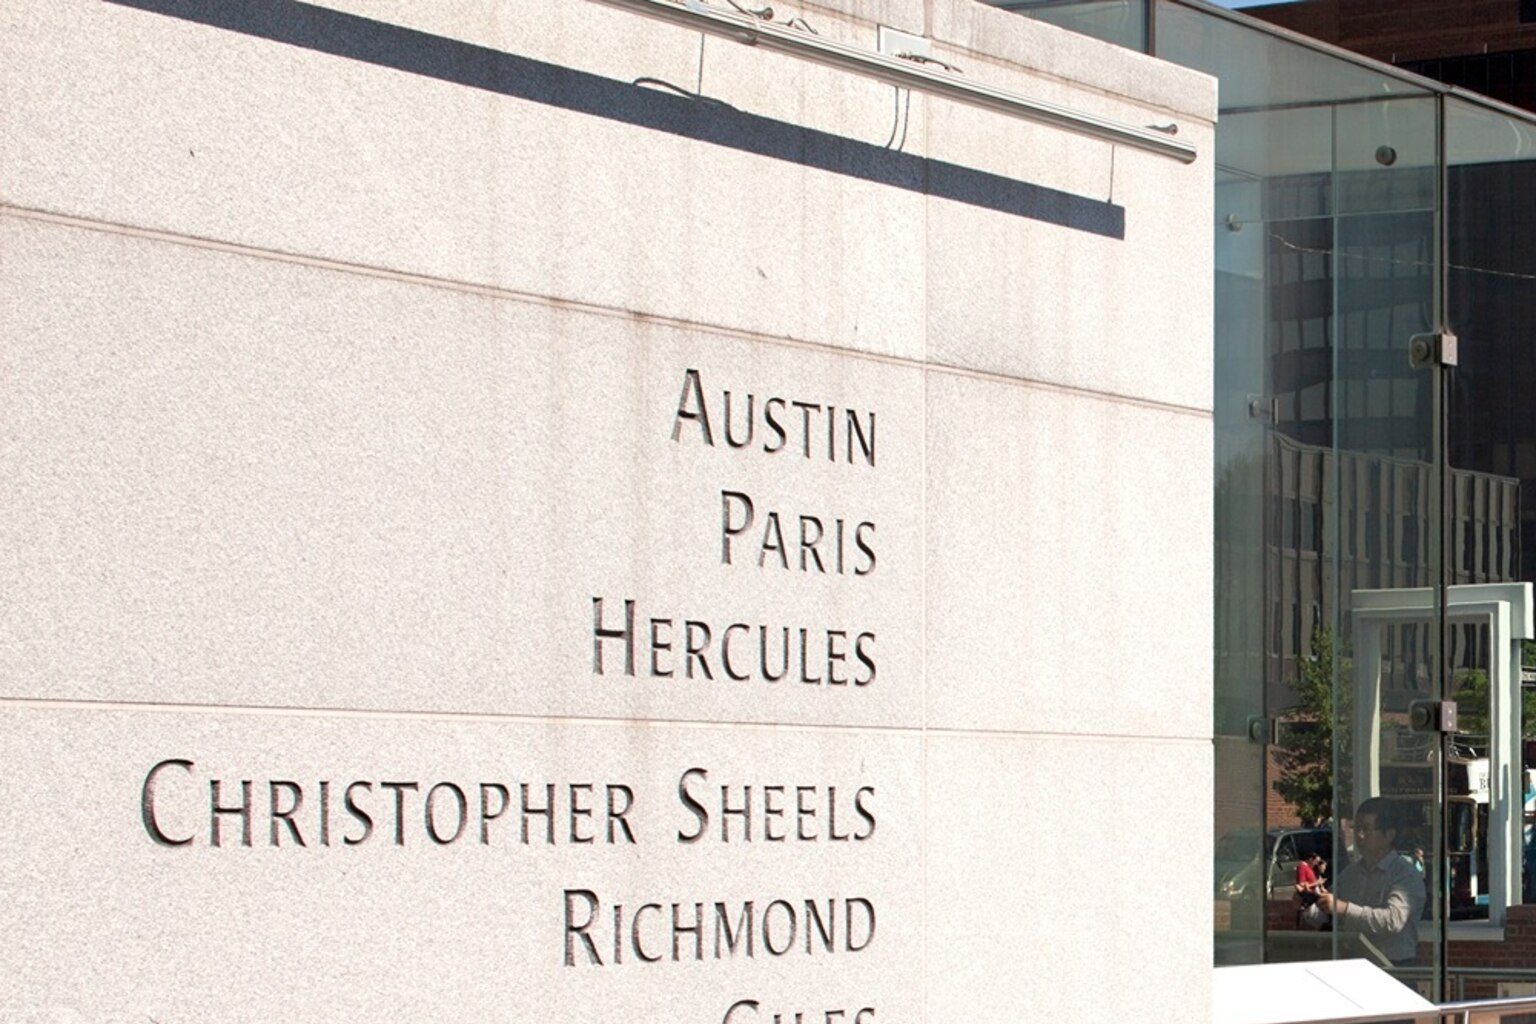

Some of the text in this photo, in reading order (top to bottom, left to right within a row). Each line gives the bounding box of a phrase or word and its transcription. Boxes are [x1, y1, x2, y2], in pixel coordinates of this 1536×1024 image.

[671, 368, 877, 468] AUSTIN
[720, 488, 877, 577] PARIS
[591, 596, 877, 688] HERCULES
[140, 757, 877, 848] CHRISTOPHER SHEELS
[562, 888, 877, 968] RICHMOND
